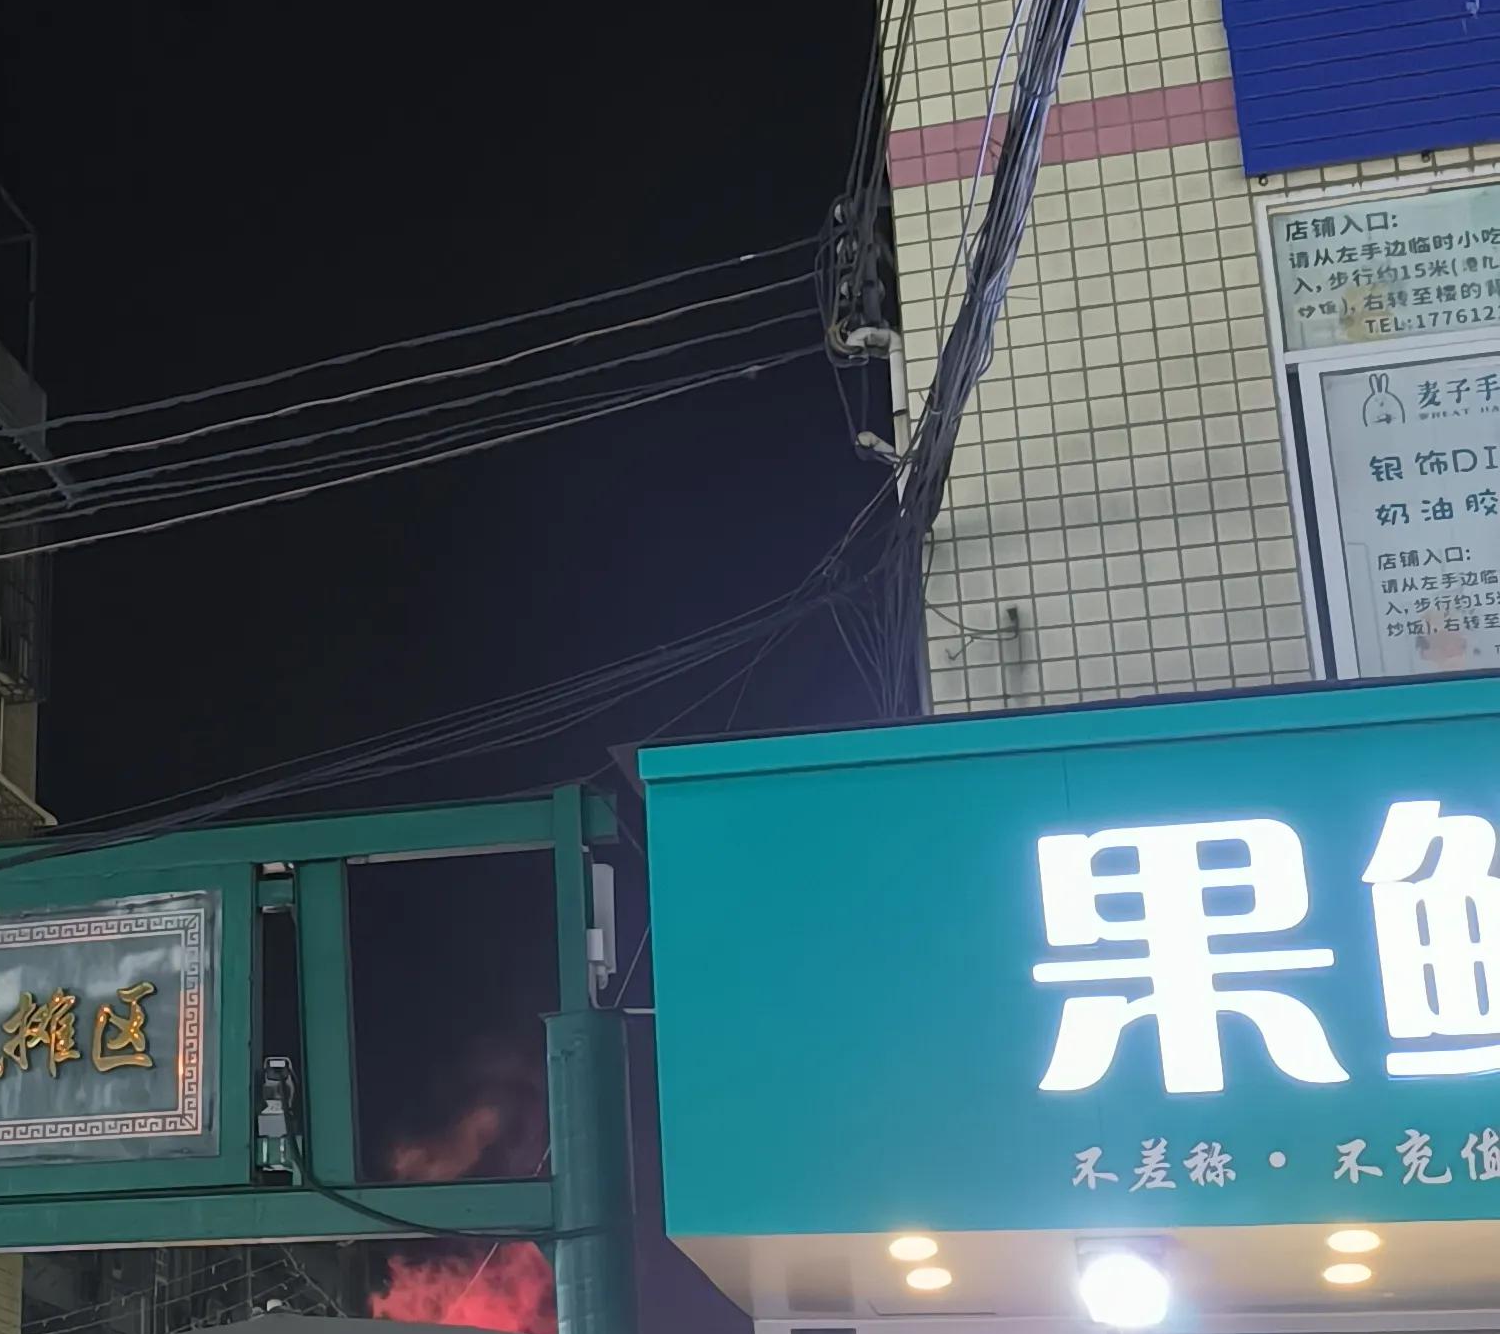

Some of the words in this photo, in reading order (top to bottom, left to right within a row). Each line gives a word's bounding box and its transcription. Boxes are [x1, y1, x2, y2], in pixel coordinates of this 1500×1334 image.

[1286, 211, 1398, 242] 店铺入口:
[1365, 305, 1500, 334] TEL:177612
[1375, 488, 1499, 526] 奶油胶
[1378, 546, 1471, 571] 店铺入口:
